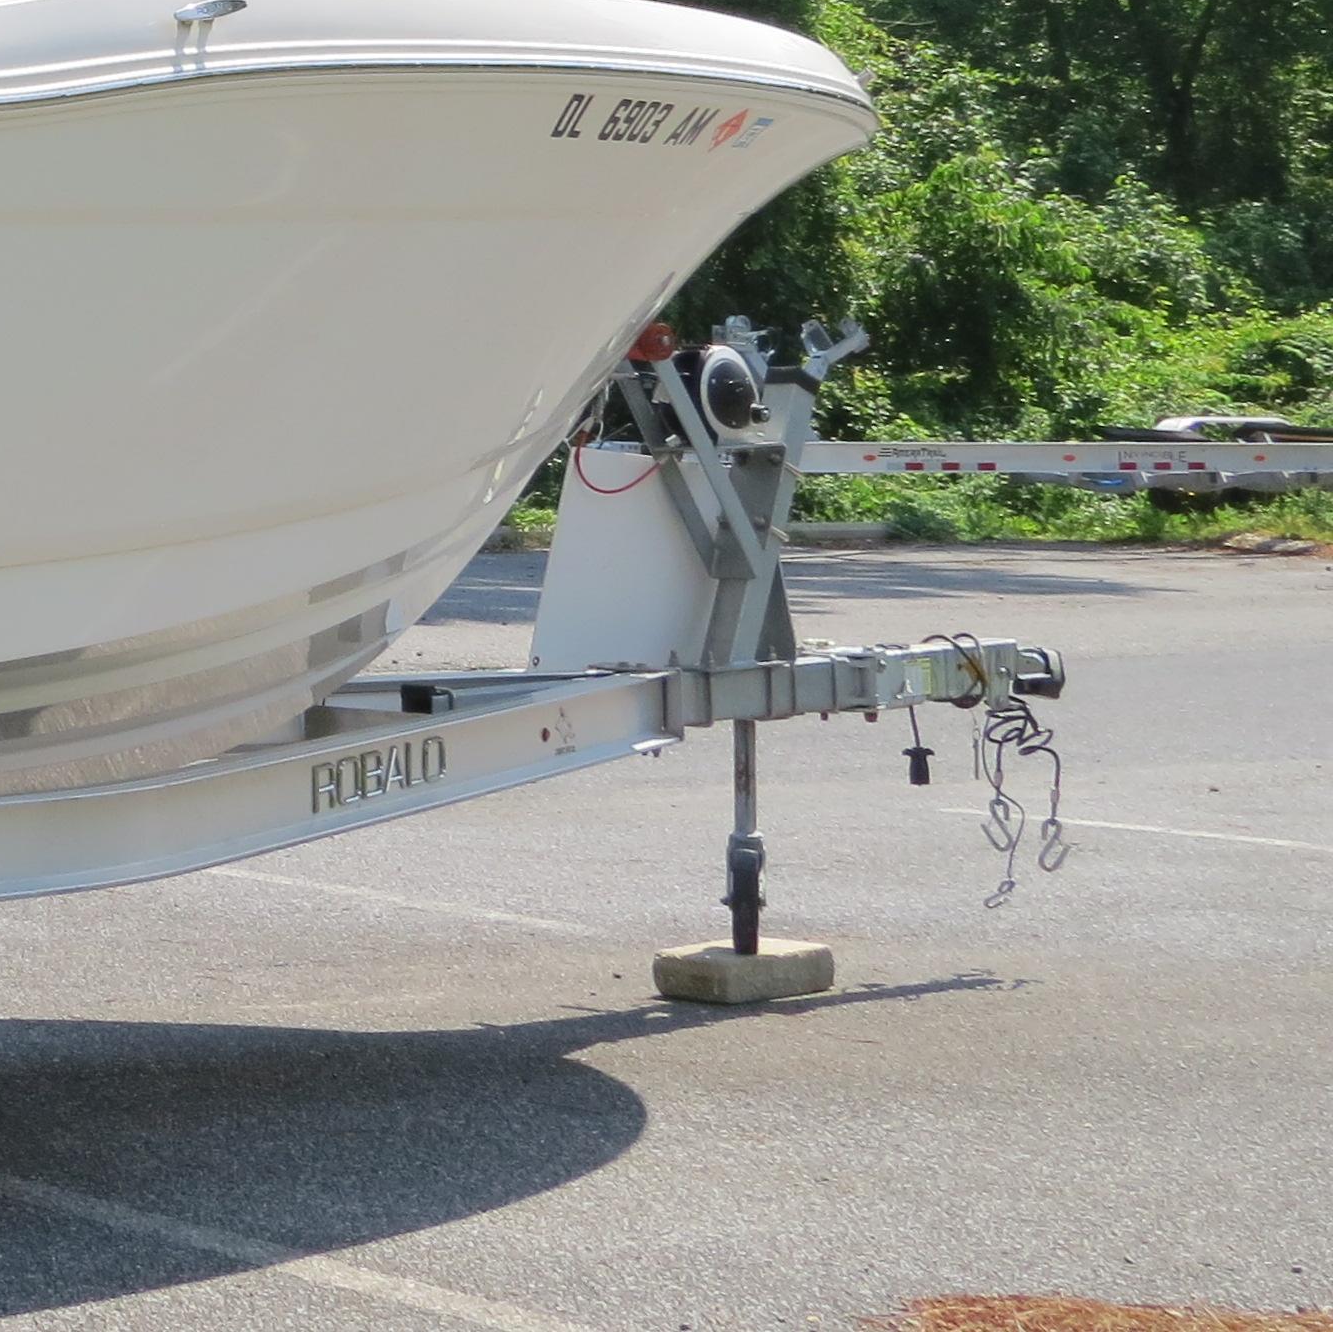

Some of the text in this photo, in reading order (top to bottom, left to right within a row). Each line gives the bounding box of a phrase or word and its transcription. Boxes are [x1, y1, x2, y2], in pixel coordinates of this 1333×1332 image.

[551, 94, 594, 138] DL
[598, 99, 674, 144] 6903
[663, 107, 720, 146] AM
[312, 735, 447, 814] ROBALO
